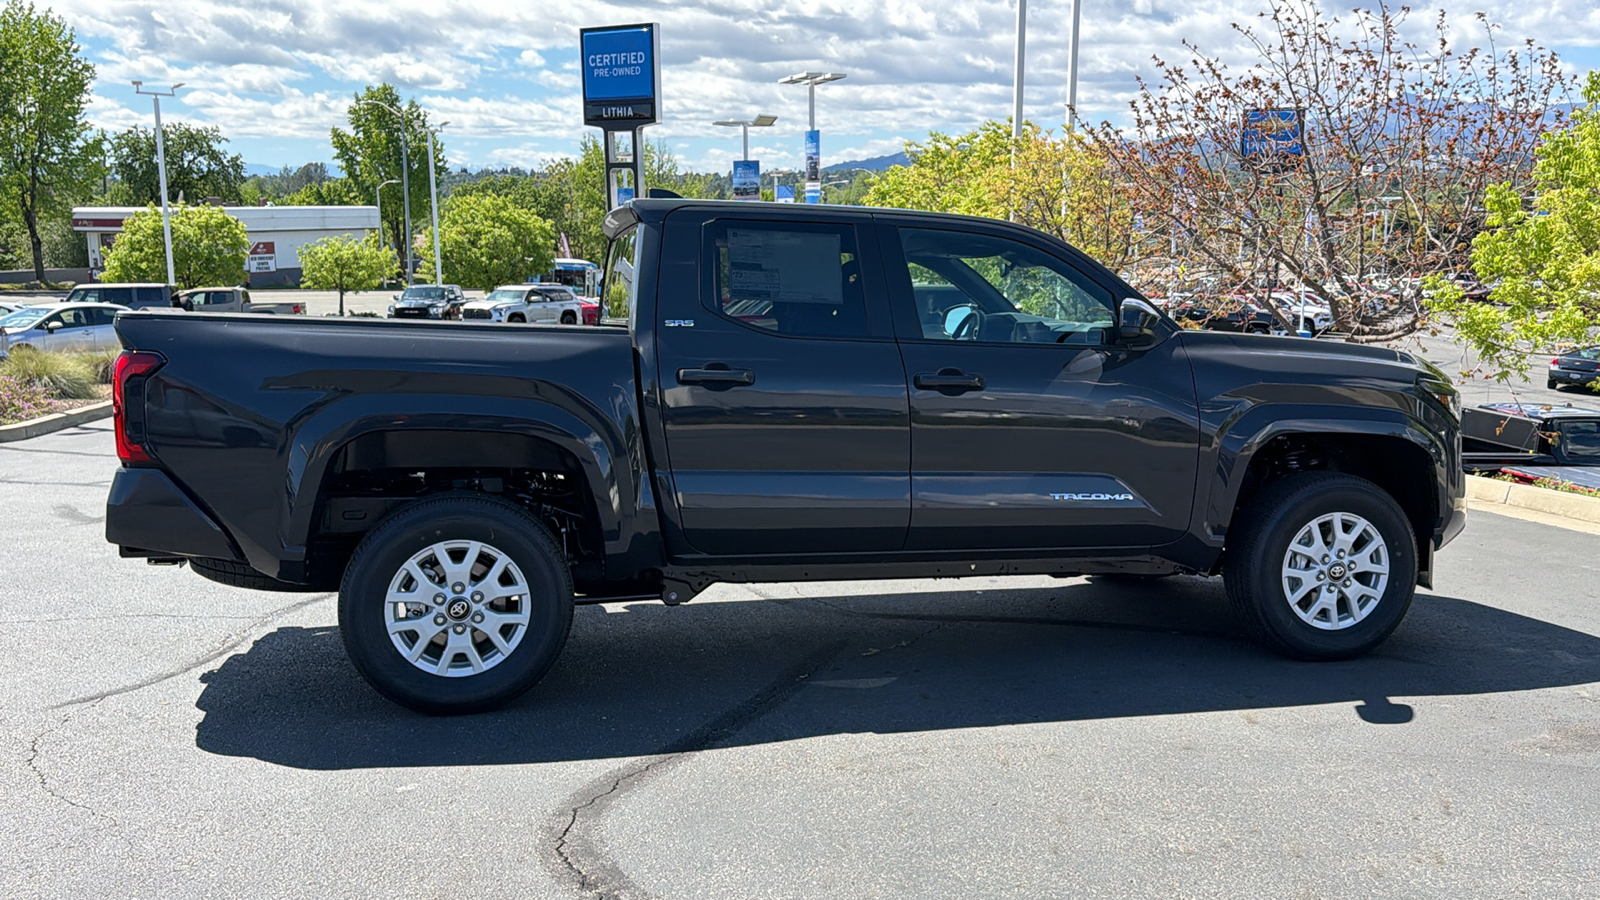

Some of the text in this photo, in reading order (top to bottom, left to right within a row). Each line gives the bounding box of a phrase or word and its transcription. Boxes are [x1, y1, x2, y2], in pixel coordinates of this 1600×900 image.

[588, 51, 645, 67] CERTIFIED
[593, 66, 641, 78] PRE-OWNED
[602, 106, 634, 118] LITHIA
[664, 319, 695, 327] SR5
[1048, 492, 1134, 501] TACOMA
